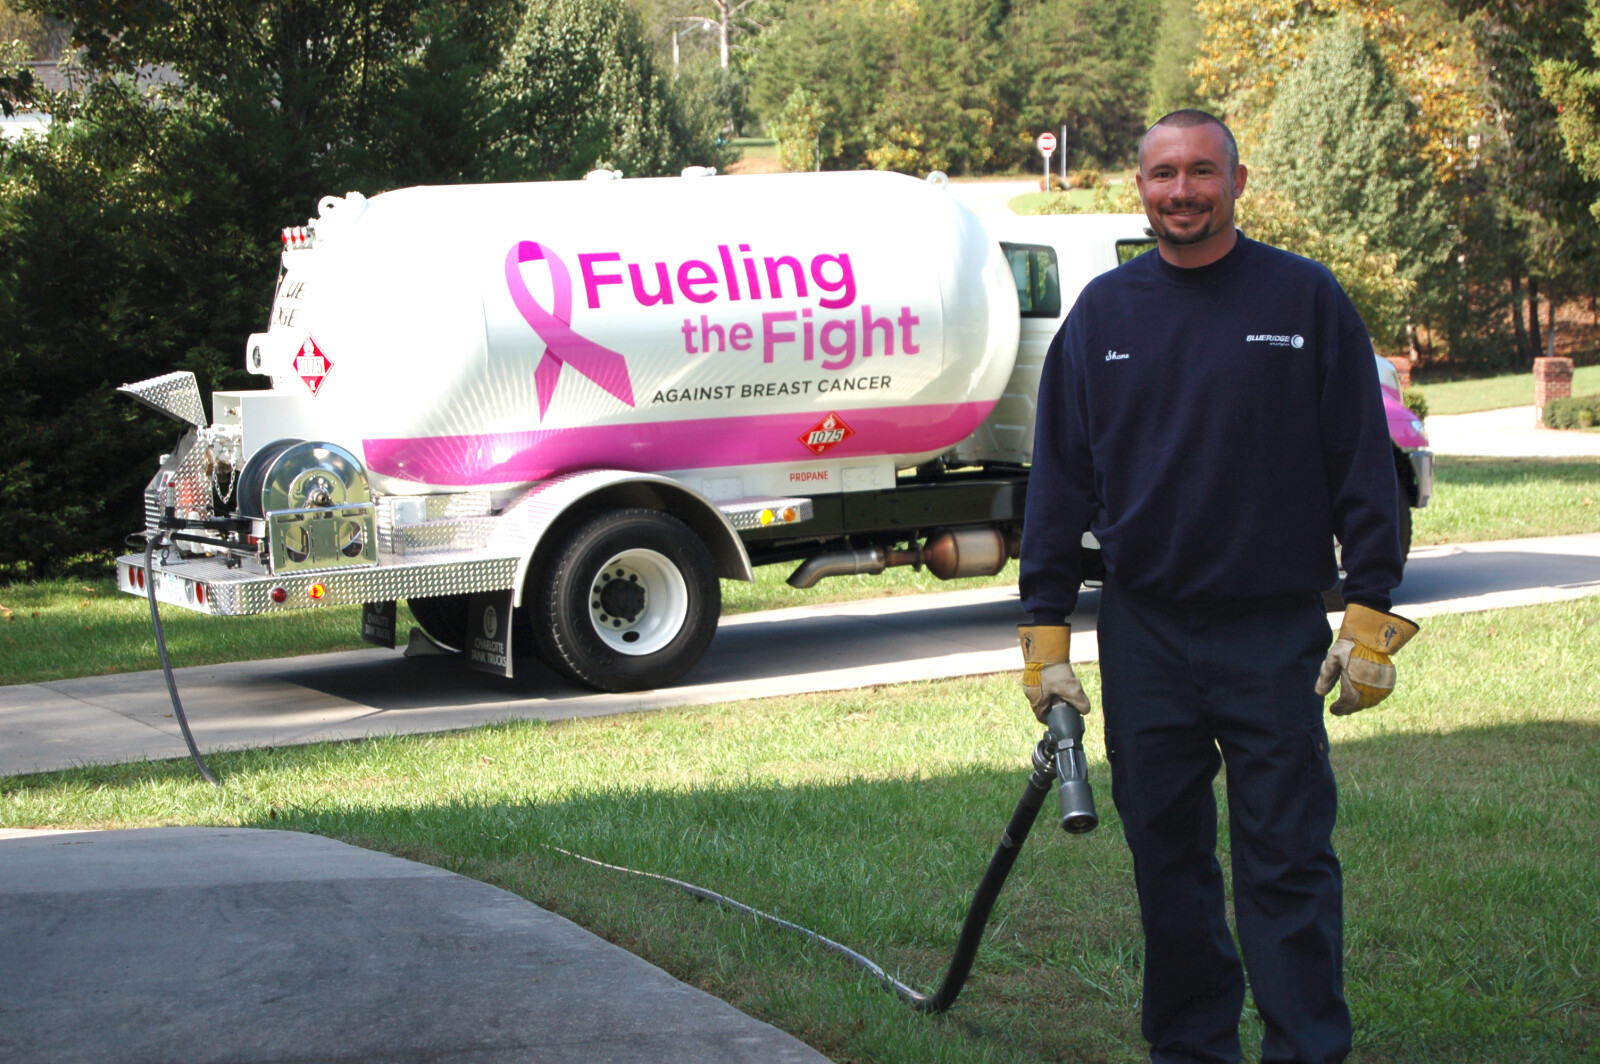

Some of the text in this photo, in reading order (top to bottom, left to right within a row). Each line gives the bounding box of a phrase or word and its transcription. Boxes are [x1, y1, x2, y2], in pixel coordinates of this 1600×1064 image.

[577, 243, 857, 310] Fueling
[681, 304, 920, 371] the Fight
[1105, 350, 1130, 361] Shane
[298, 358, 323, 375] 1075
[652, 375, 892, 404] AGAINST BREAST CANCER
[810, 429, 843, 444] 1075
[789, 470, 829, 482] PROPANE
